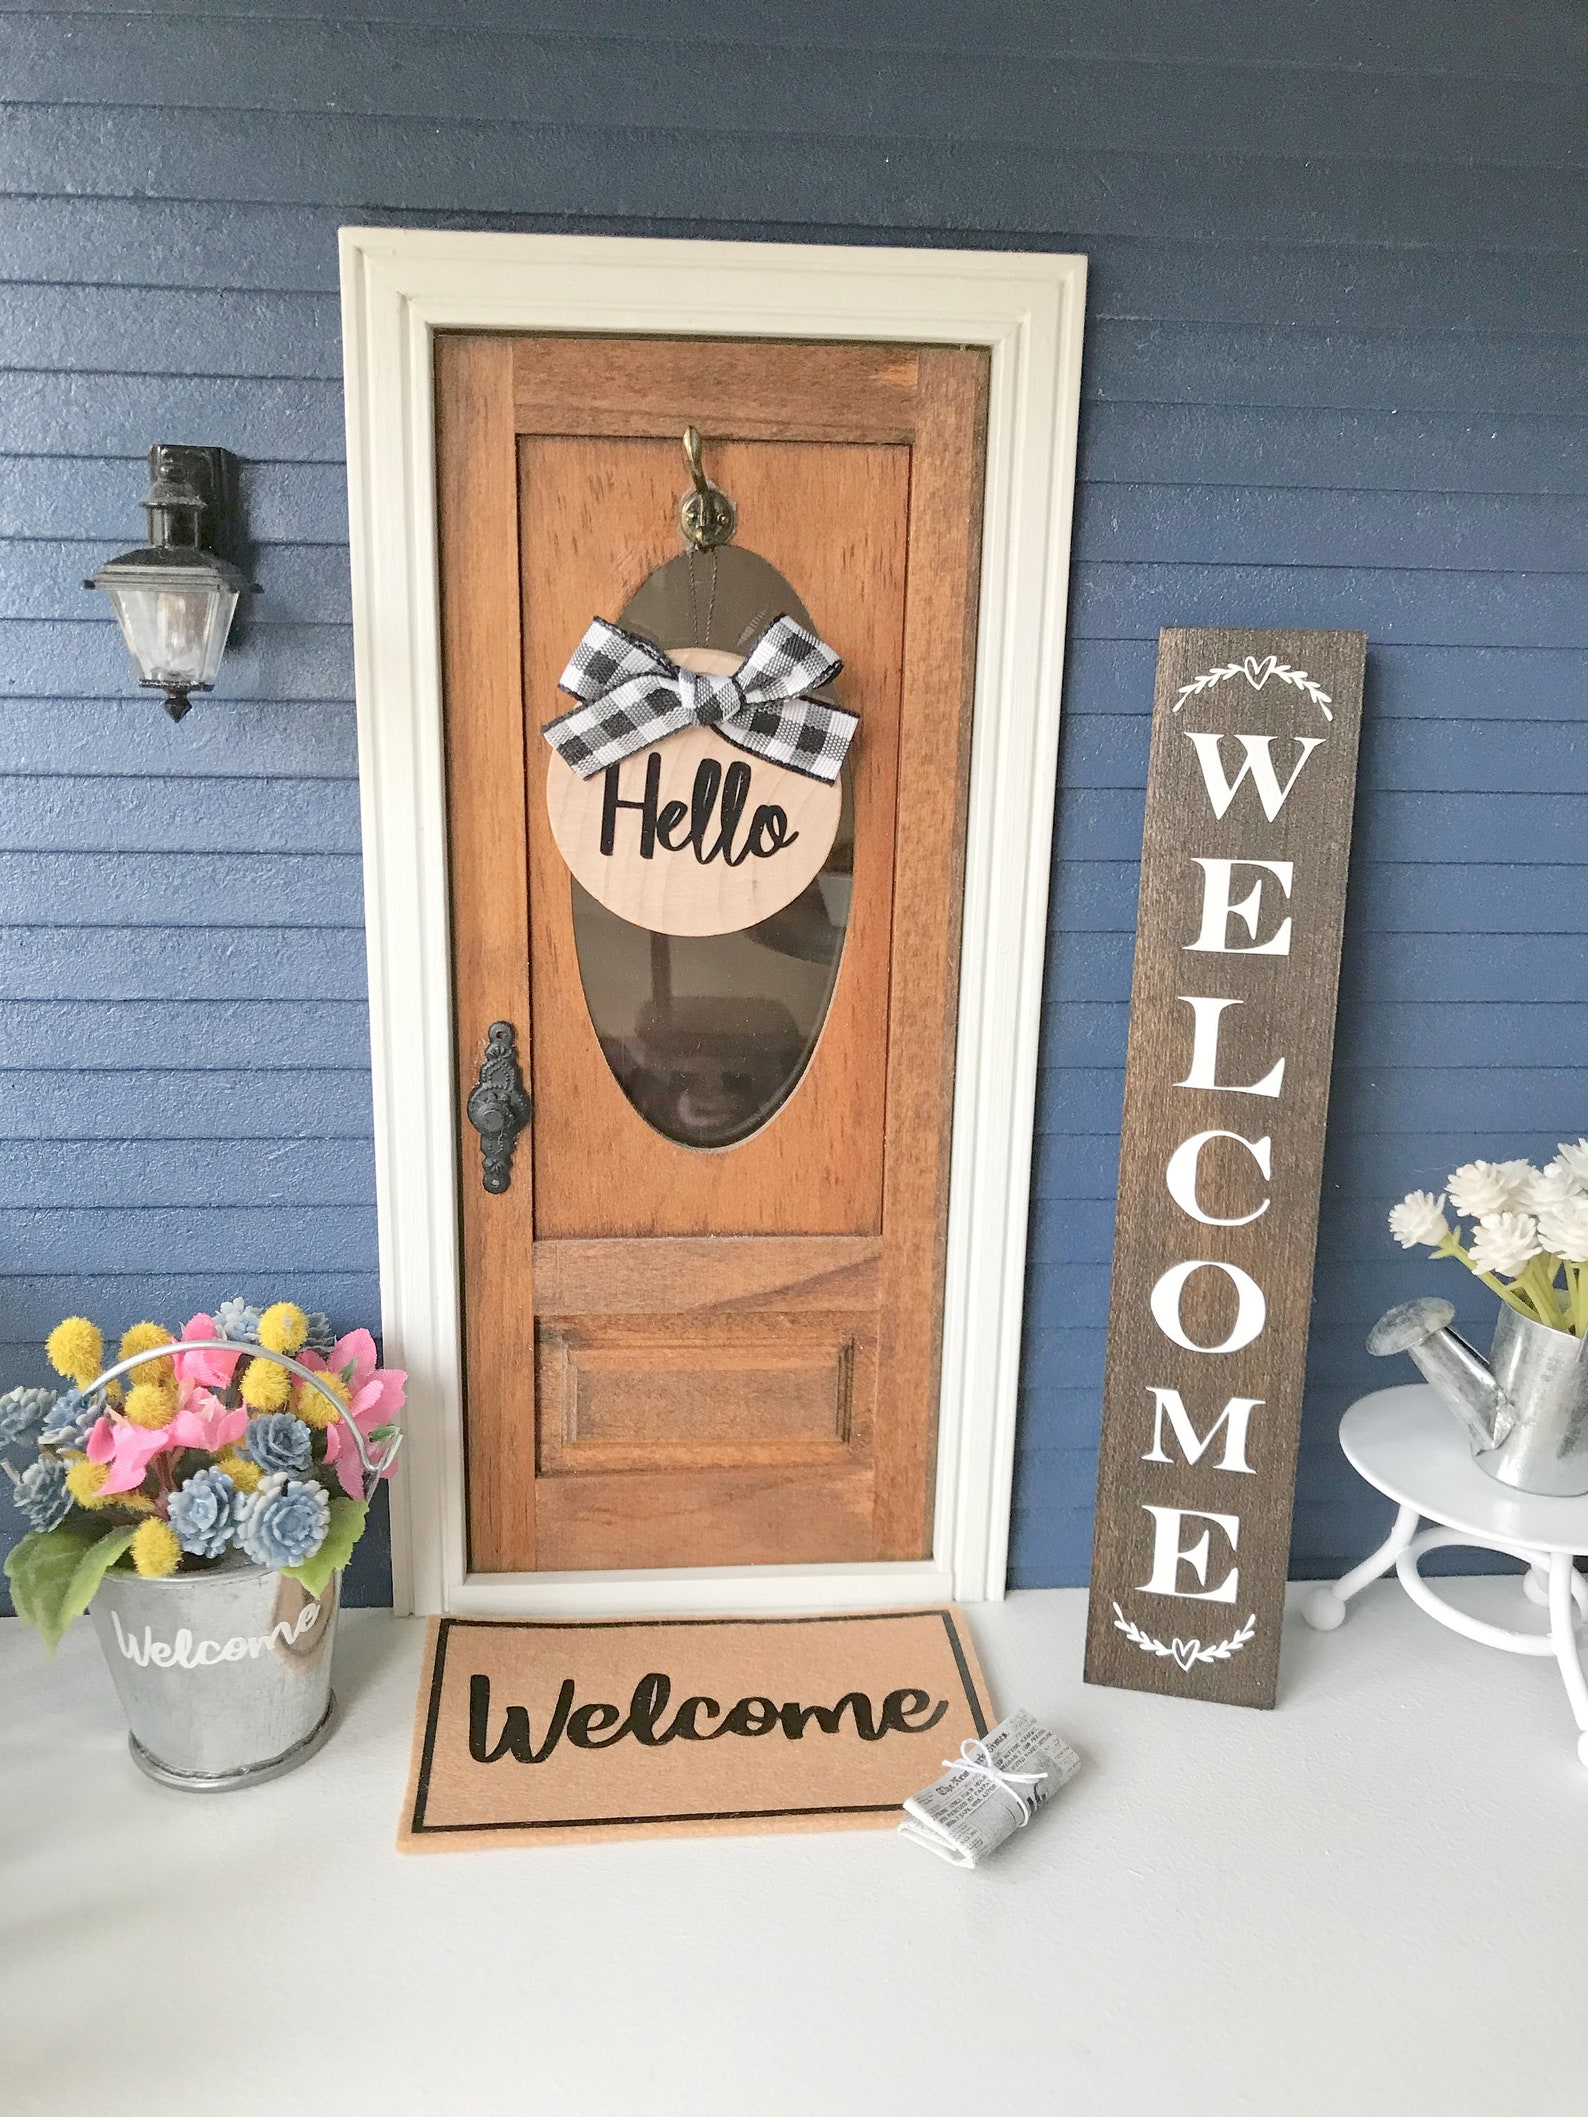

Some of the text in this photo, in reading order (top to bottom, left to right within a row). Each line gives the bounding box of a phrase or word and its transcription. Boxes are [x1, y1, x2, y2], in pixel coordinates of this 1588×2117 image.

[599, 752, 800, 867] Hello
[1134, 731, 1327, 1604] WELCOME
[111, 1602, 322, 1669] Welcome
[468, 1673, 949, 1765] Welcome
[935, 1780, 955, 1796] The
[948, 1769, 970, 1787] New
